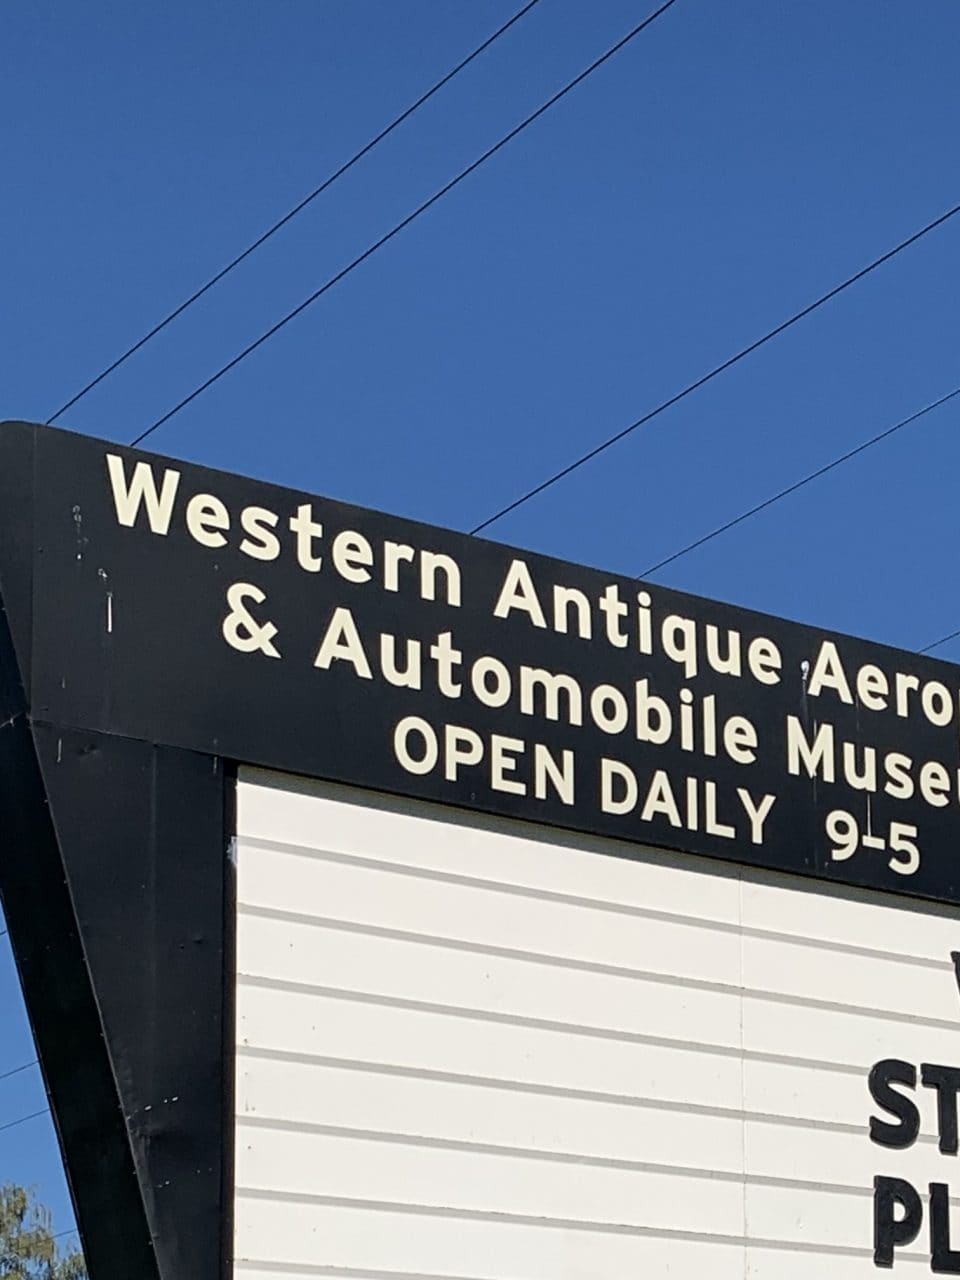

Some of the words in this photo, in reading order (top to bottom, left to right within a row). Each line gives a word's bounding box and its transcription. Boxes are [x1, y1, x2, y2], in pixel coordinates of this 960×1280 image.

[106, 453, 462, 608] Western
[493, 559, 783, 685] Antique
[221, 582, 283, 659] &
[313, 607, 759, 764] Automobile
[394, 716, 575, 806] OPEN
[600, 757, 776, 845] DAILY
[825, 809, 921, 876] 9-5
